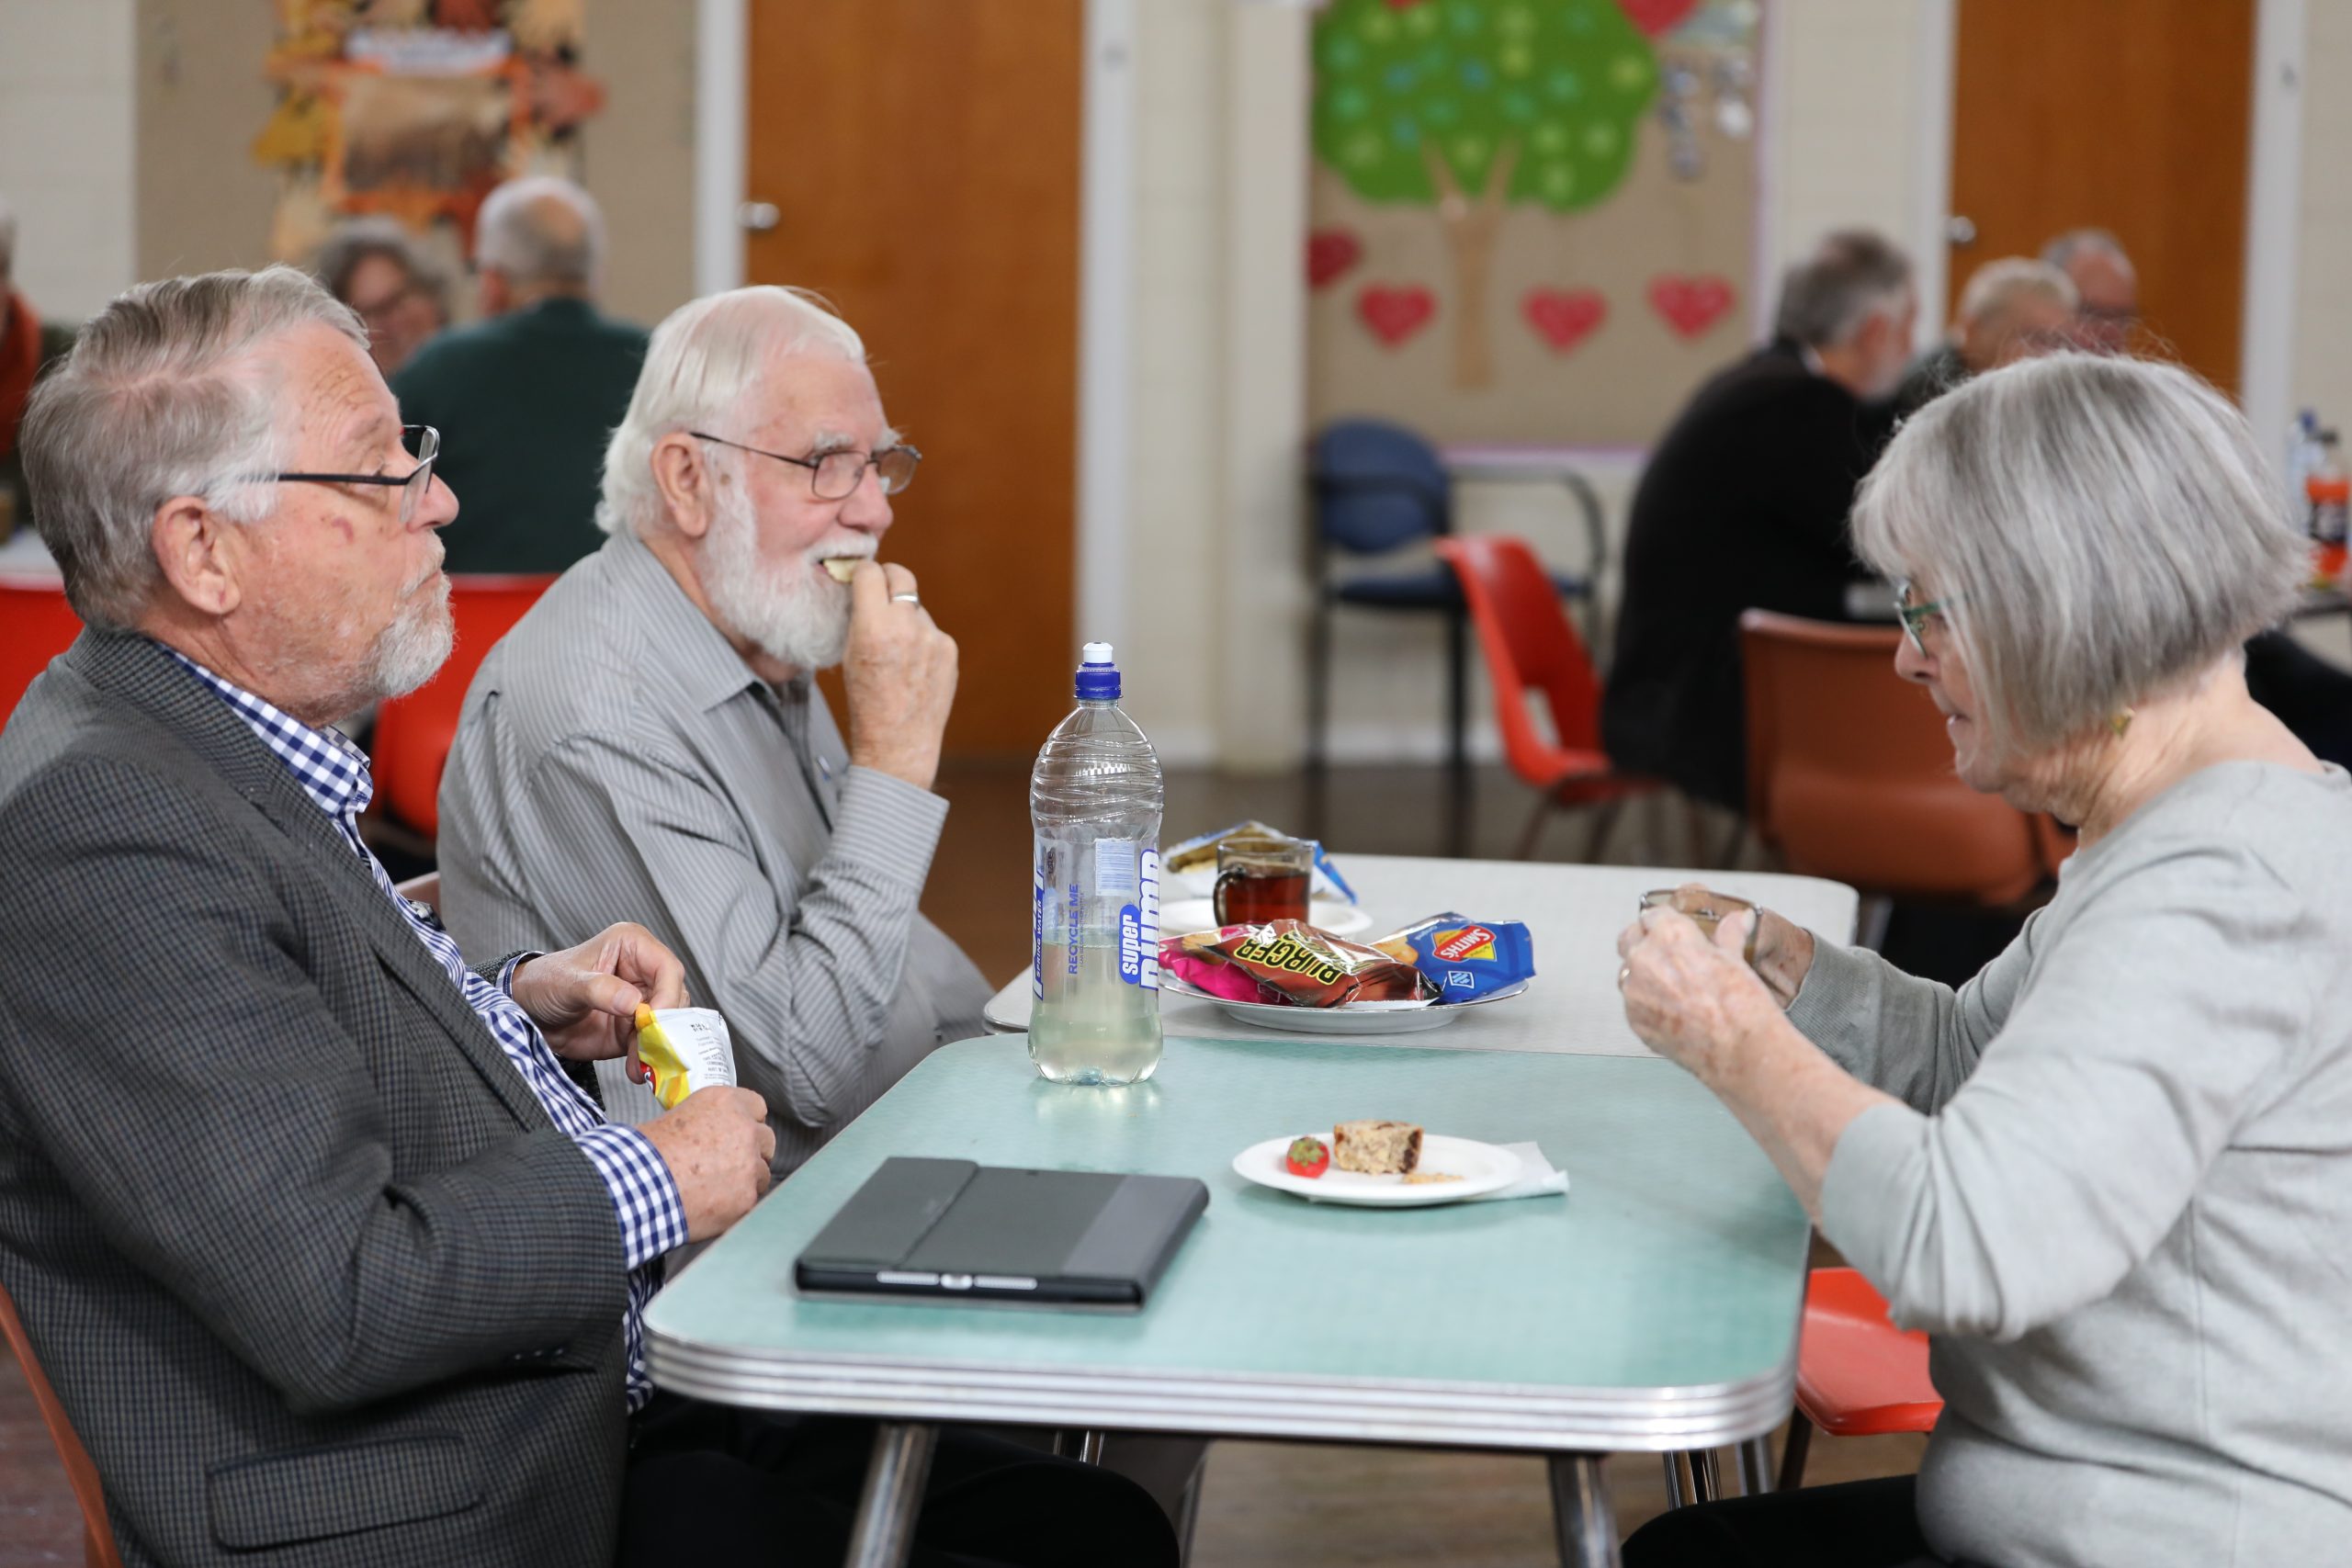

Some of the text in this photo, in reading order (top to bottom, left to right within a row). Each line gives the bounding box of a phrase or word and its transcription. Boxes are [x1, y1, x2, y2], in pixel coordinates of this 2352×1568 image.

[1069, 884, 1079, 975] RECYCLE ME
[1121, 915, 1140, 976] super
[1440, 929, 1490, 959] SMITH'S
[1234, 937, 1341, 985] BURGER
